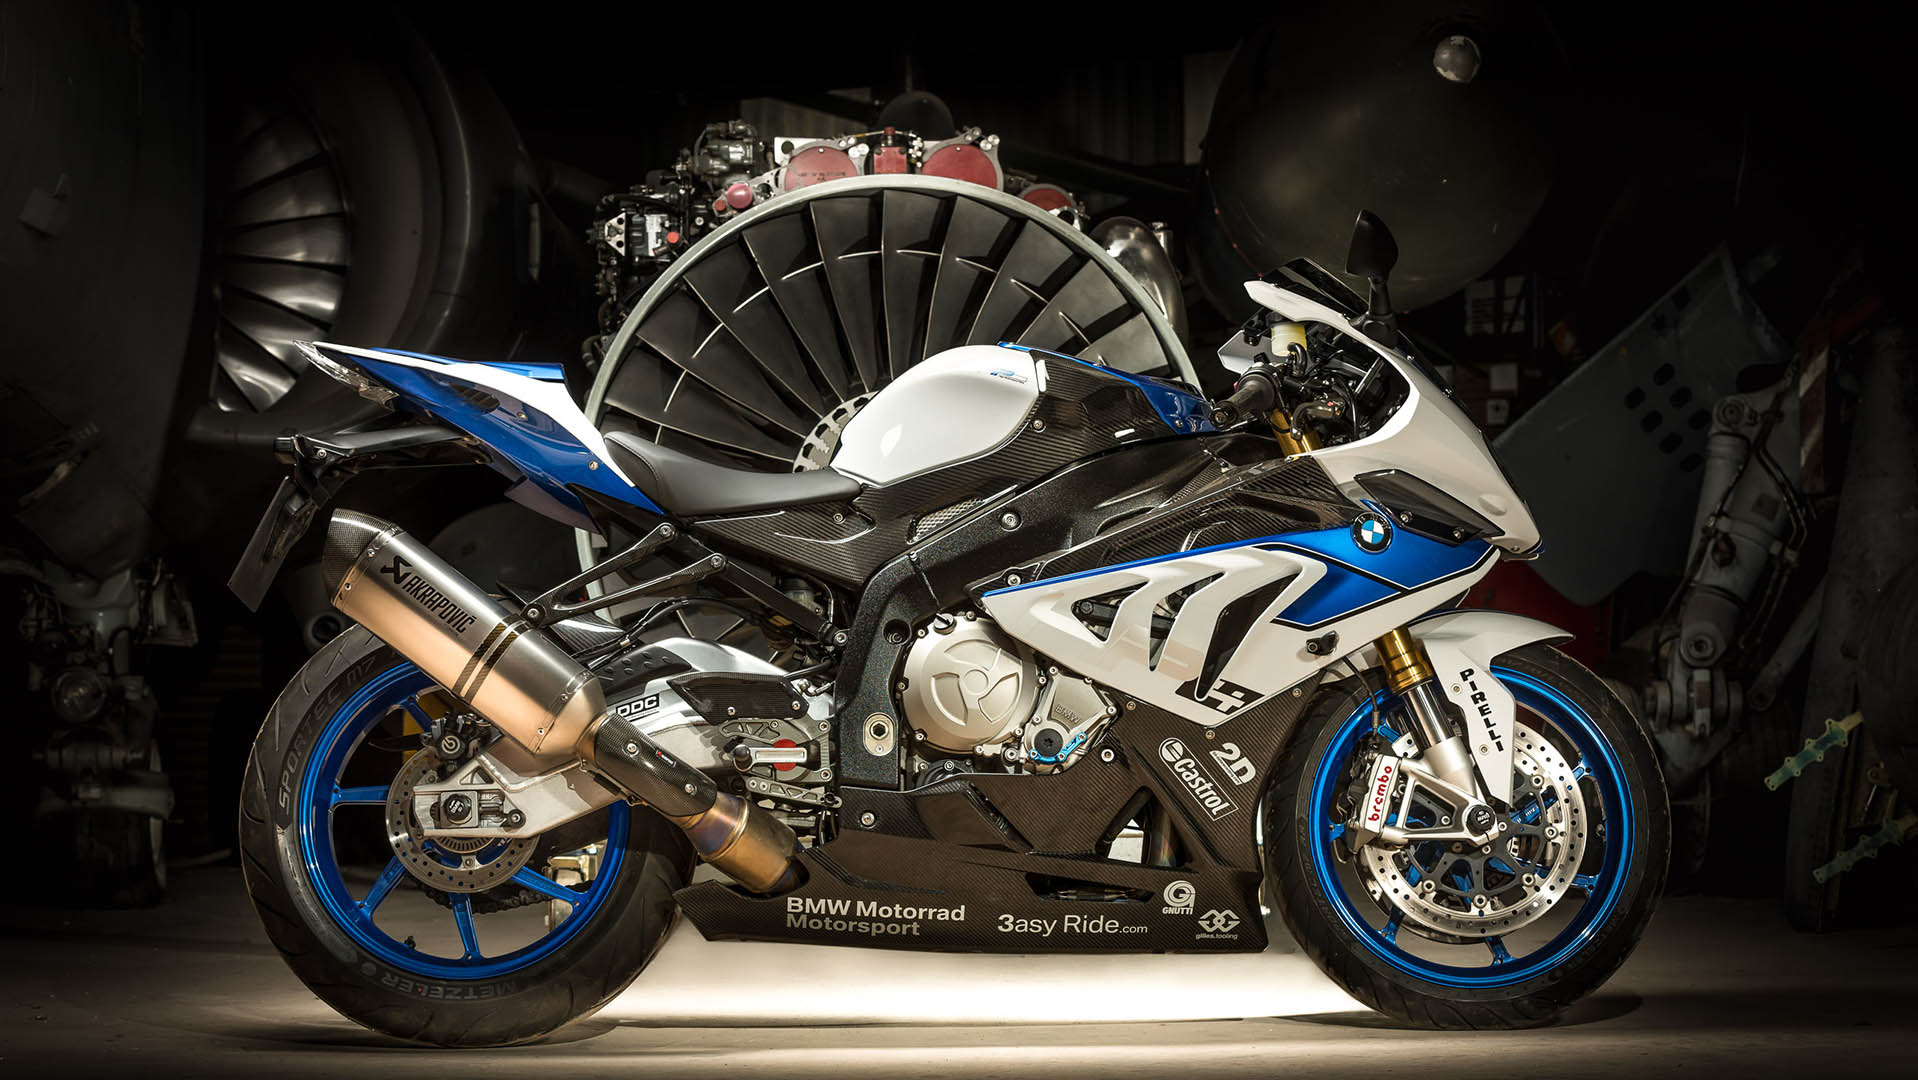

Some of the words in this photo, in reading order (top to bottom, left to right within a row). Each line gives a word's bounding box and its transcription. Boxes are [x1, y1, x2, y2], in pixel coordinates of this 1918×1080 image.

[617, 695, 657, 717] DDC
[1055, 703, 1081, 725] BMW
[1460, 668, 1504, 752] PIRELLI
[1209, 742, 1256, 786] 2D
[1173, 758, 1230, 816] Castrol
[1368, 765, 1392, 822] brembo
[786, 897, 852, 916] BMW
[856, 900, 966, 921] Motorrad
[1162, 906, 1194, 915] GNUTTI
[786, 913, 921, 936] Motorsport
[997, 914, 1057, 936] 3asy
[1063, 914, 1148, 934] Ride.com
[381, 972, 519, 1000] METZELER
